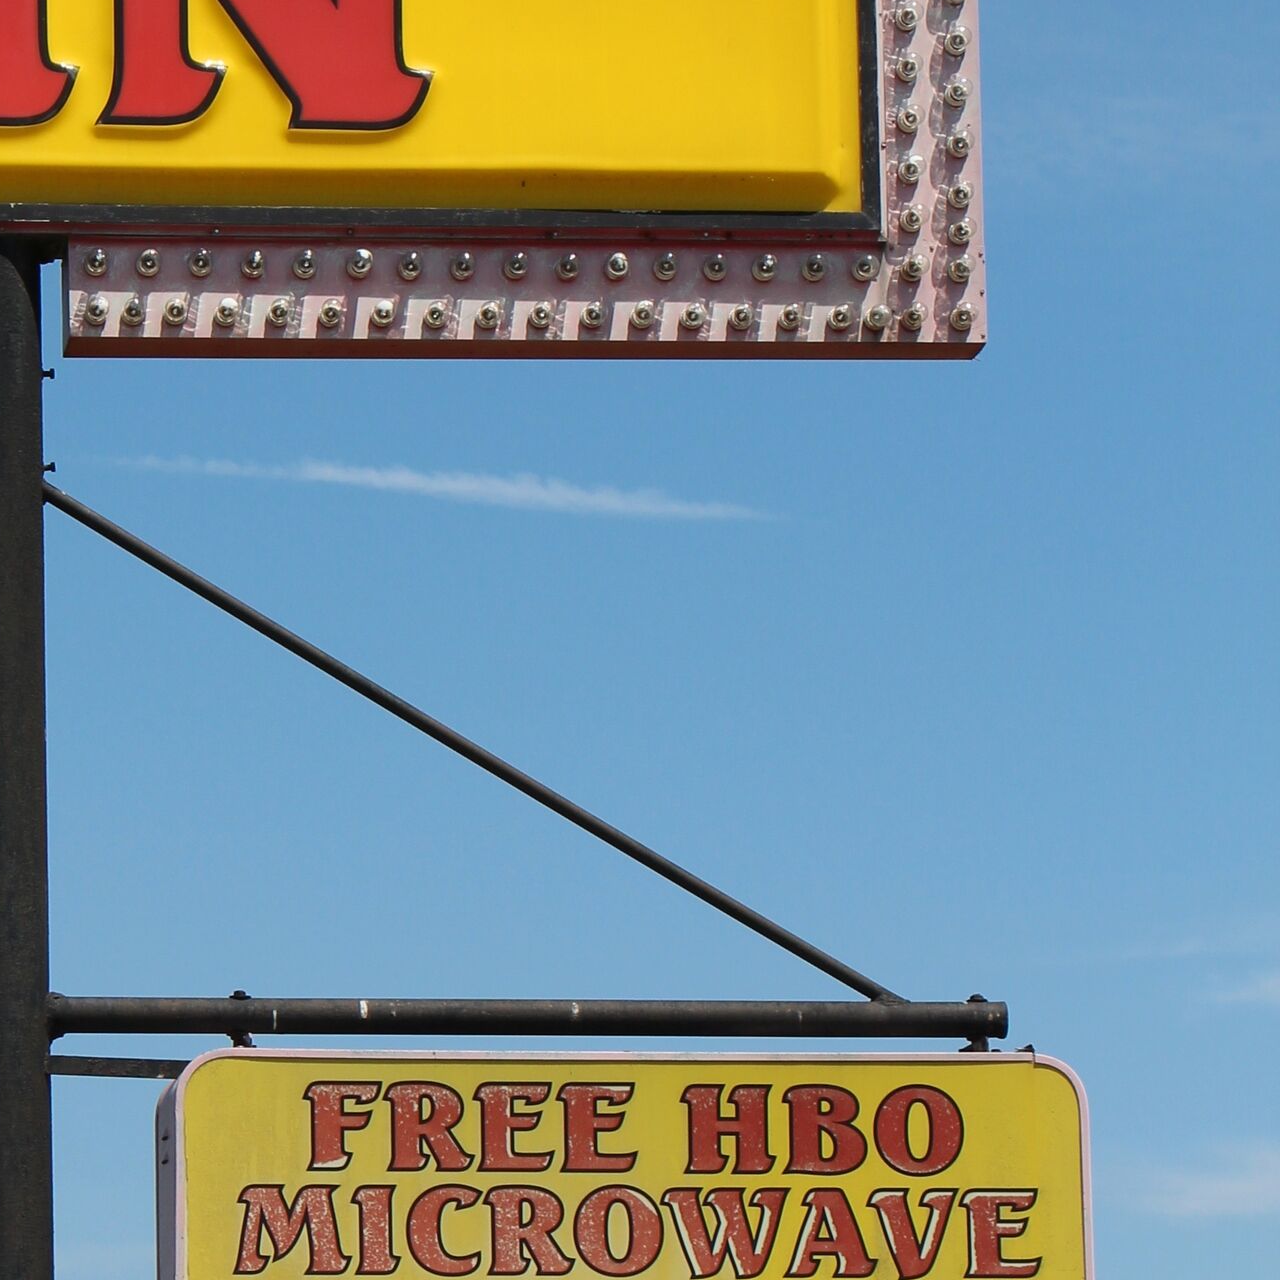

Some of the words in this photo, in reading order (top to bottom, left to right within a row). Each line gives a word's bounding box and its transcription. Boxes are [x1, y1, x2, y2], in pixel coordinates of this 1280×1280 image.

[302, 1080, 639, 1173] FREE
[679, 1084, 964, 1177] HBO
[232, 1183, 1043, 1280] MICROWAVE
